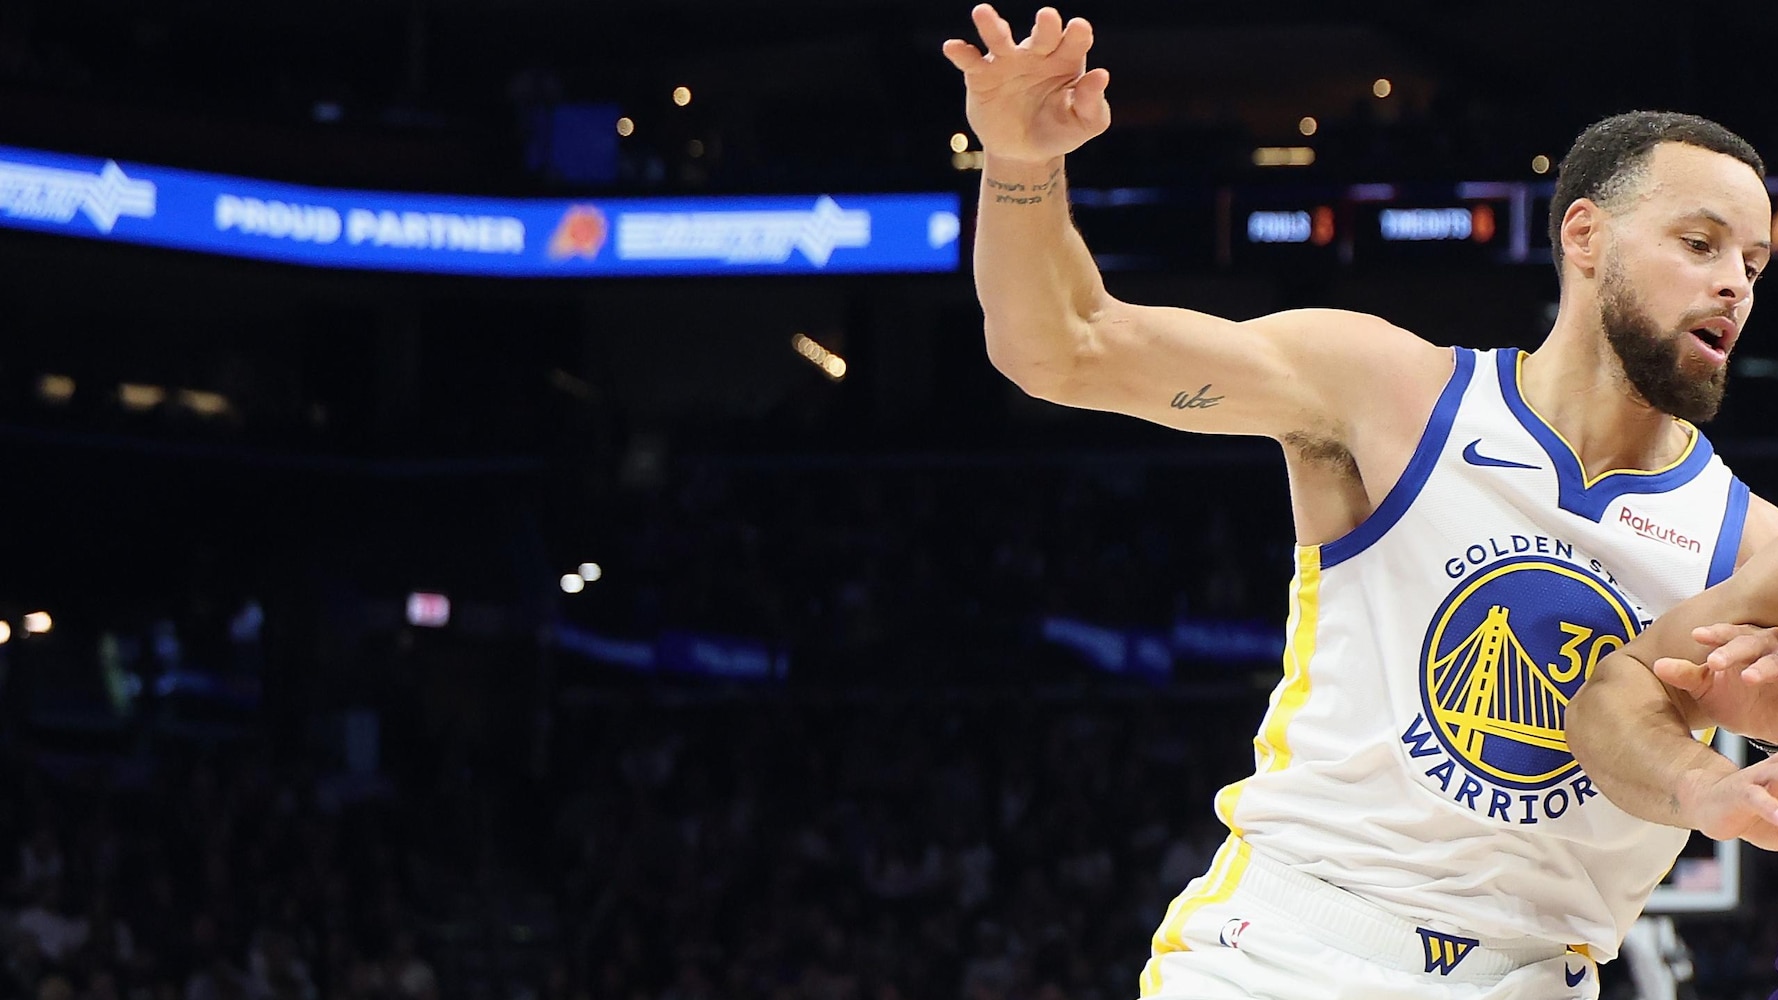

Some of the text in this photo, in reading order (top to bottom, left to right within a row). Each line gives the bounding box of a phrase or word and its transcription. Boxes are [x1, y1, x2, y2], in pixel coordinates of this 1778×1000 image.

[215, 193, 525, 254] PROUD PARTNER
[1618, 505, 1701, 554] Rakuten
[1445, 534, 1573, 579] GOLDEN
